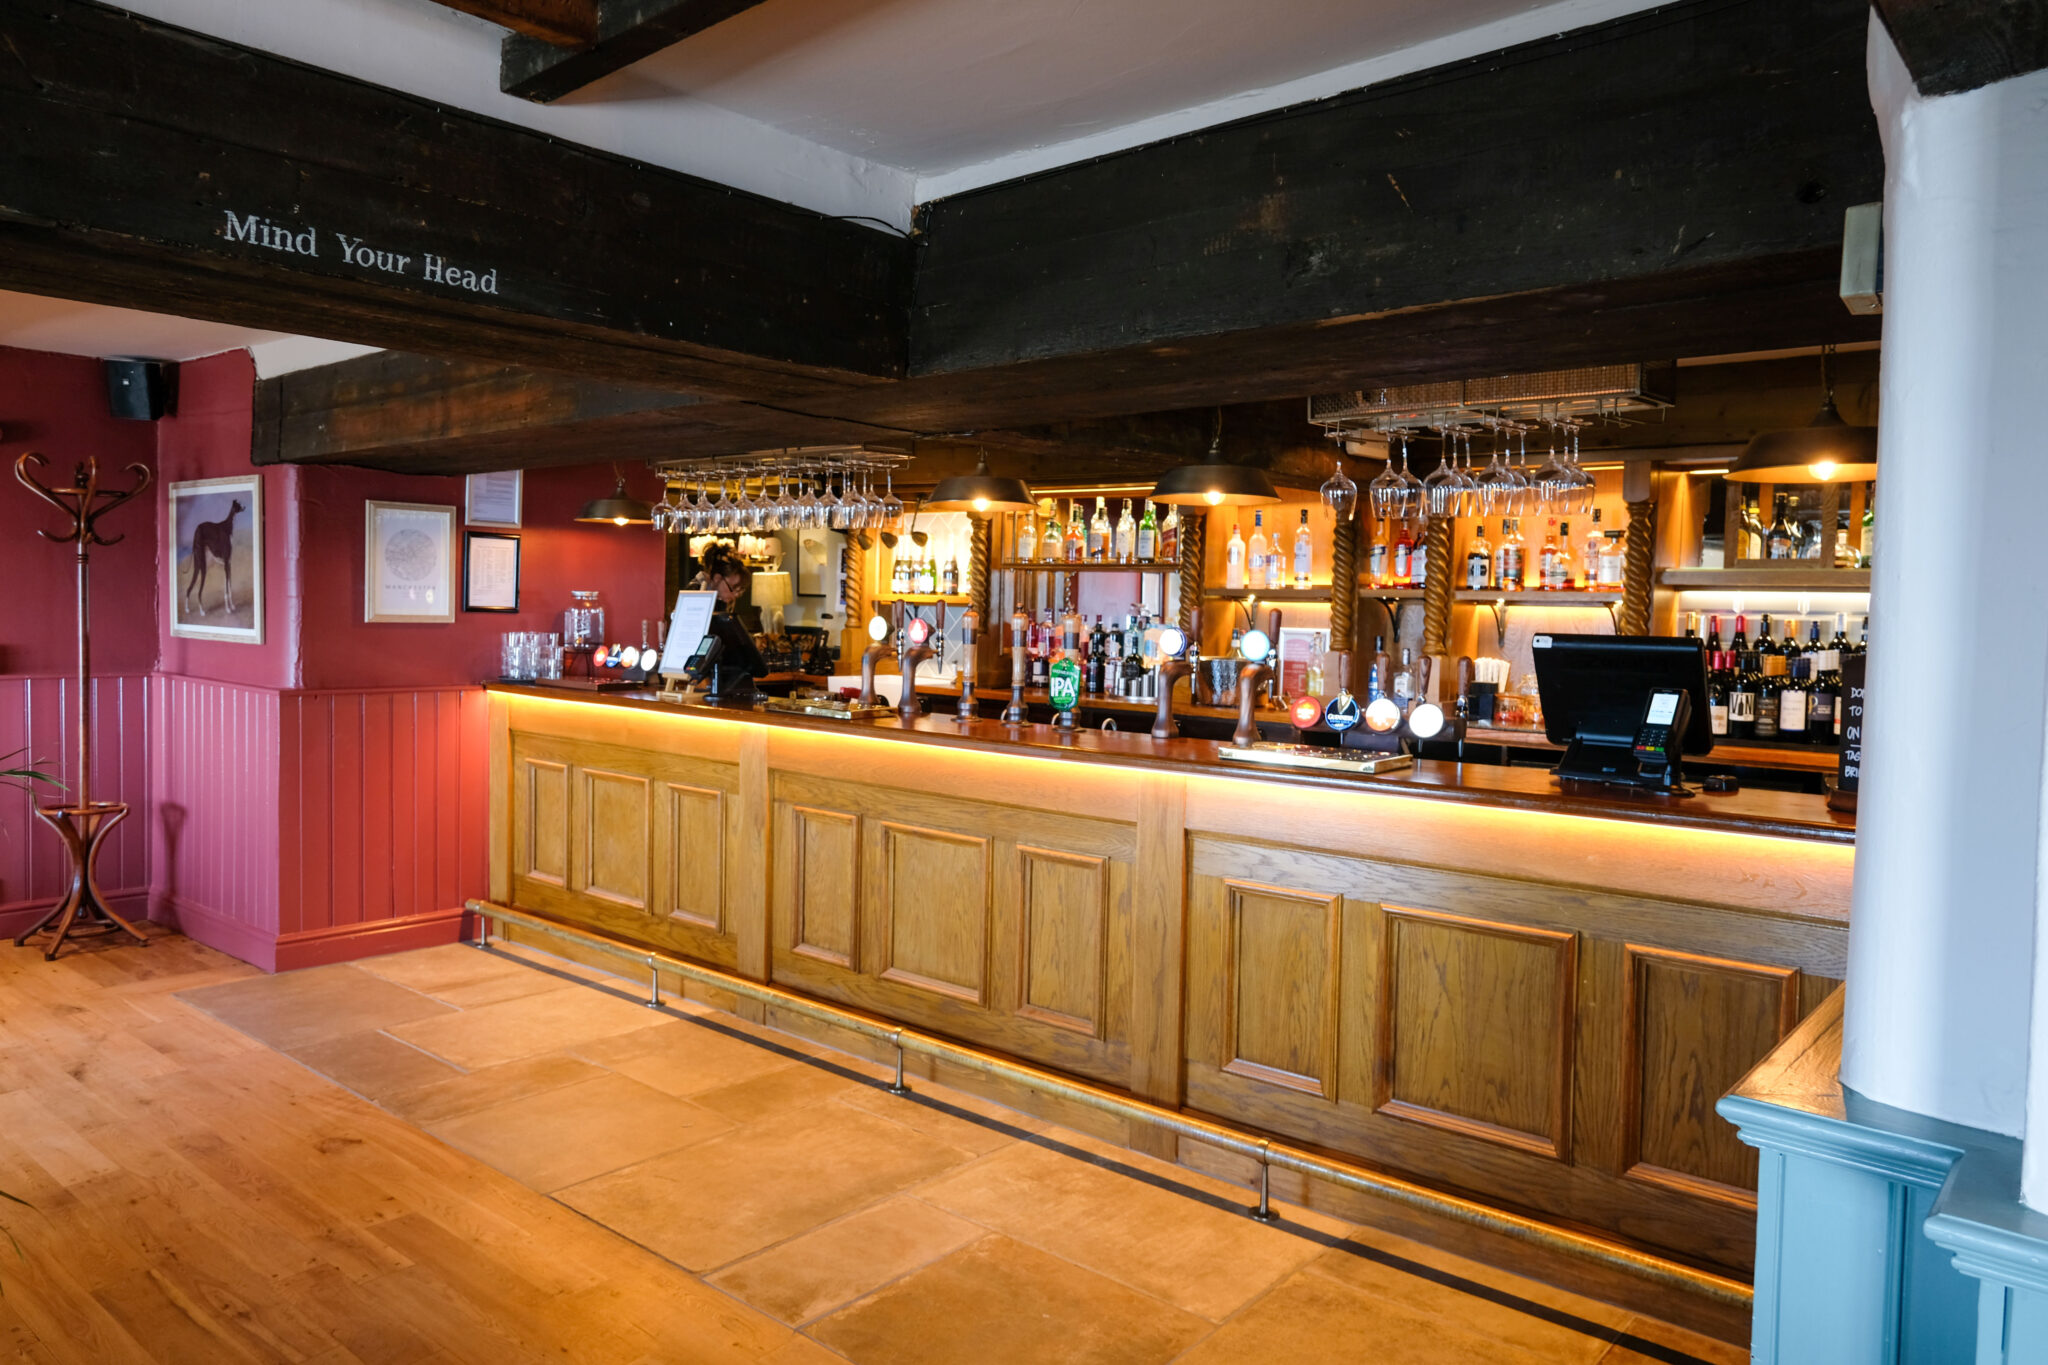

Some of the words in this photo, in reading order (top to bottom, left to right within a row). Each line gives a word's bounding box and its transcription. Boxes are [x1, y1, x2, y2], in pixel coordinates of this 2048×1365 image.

[223, 210, 319, 257] Mind
[336, 232, 411, 274] Your
[423, 253, 499, 295] Head
[1051, 677, 1076, 697] IPA
[1848, 705, 1862, 717] TO
[1847, 726, 1860, 740] ON
